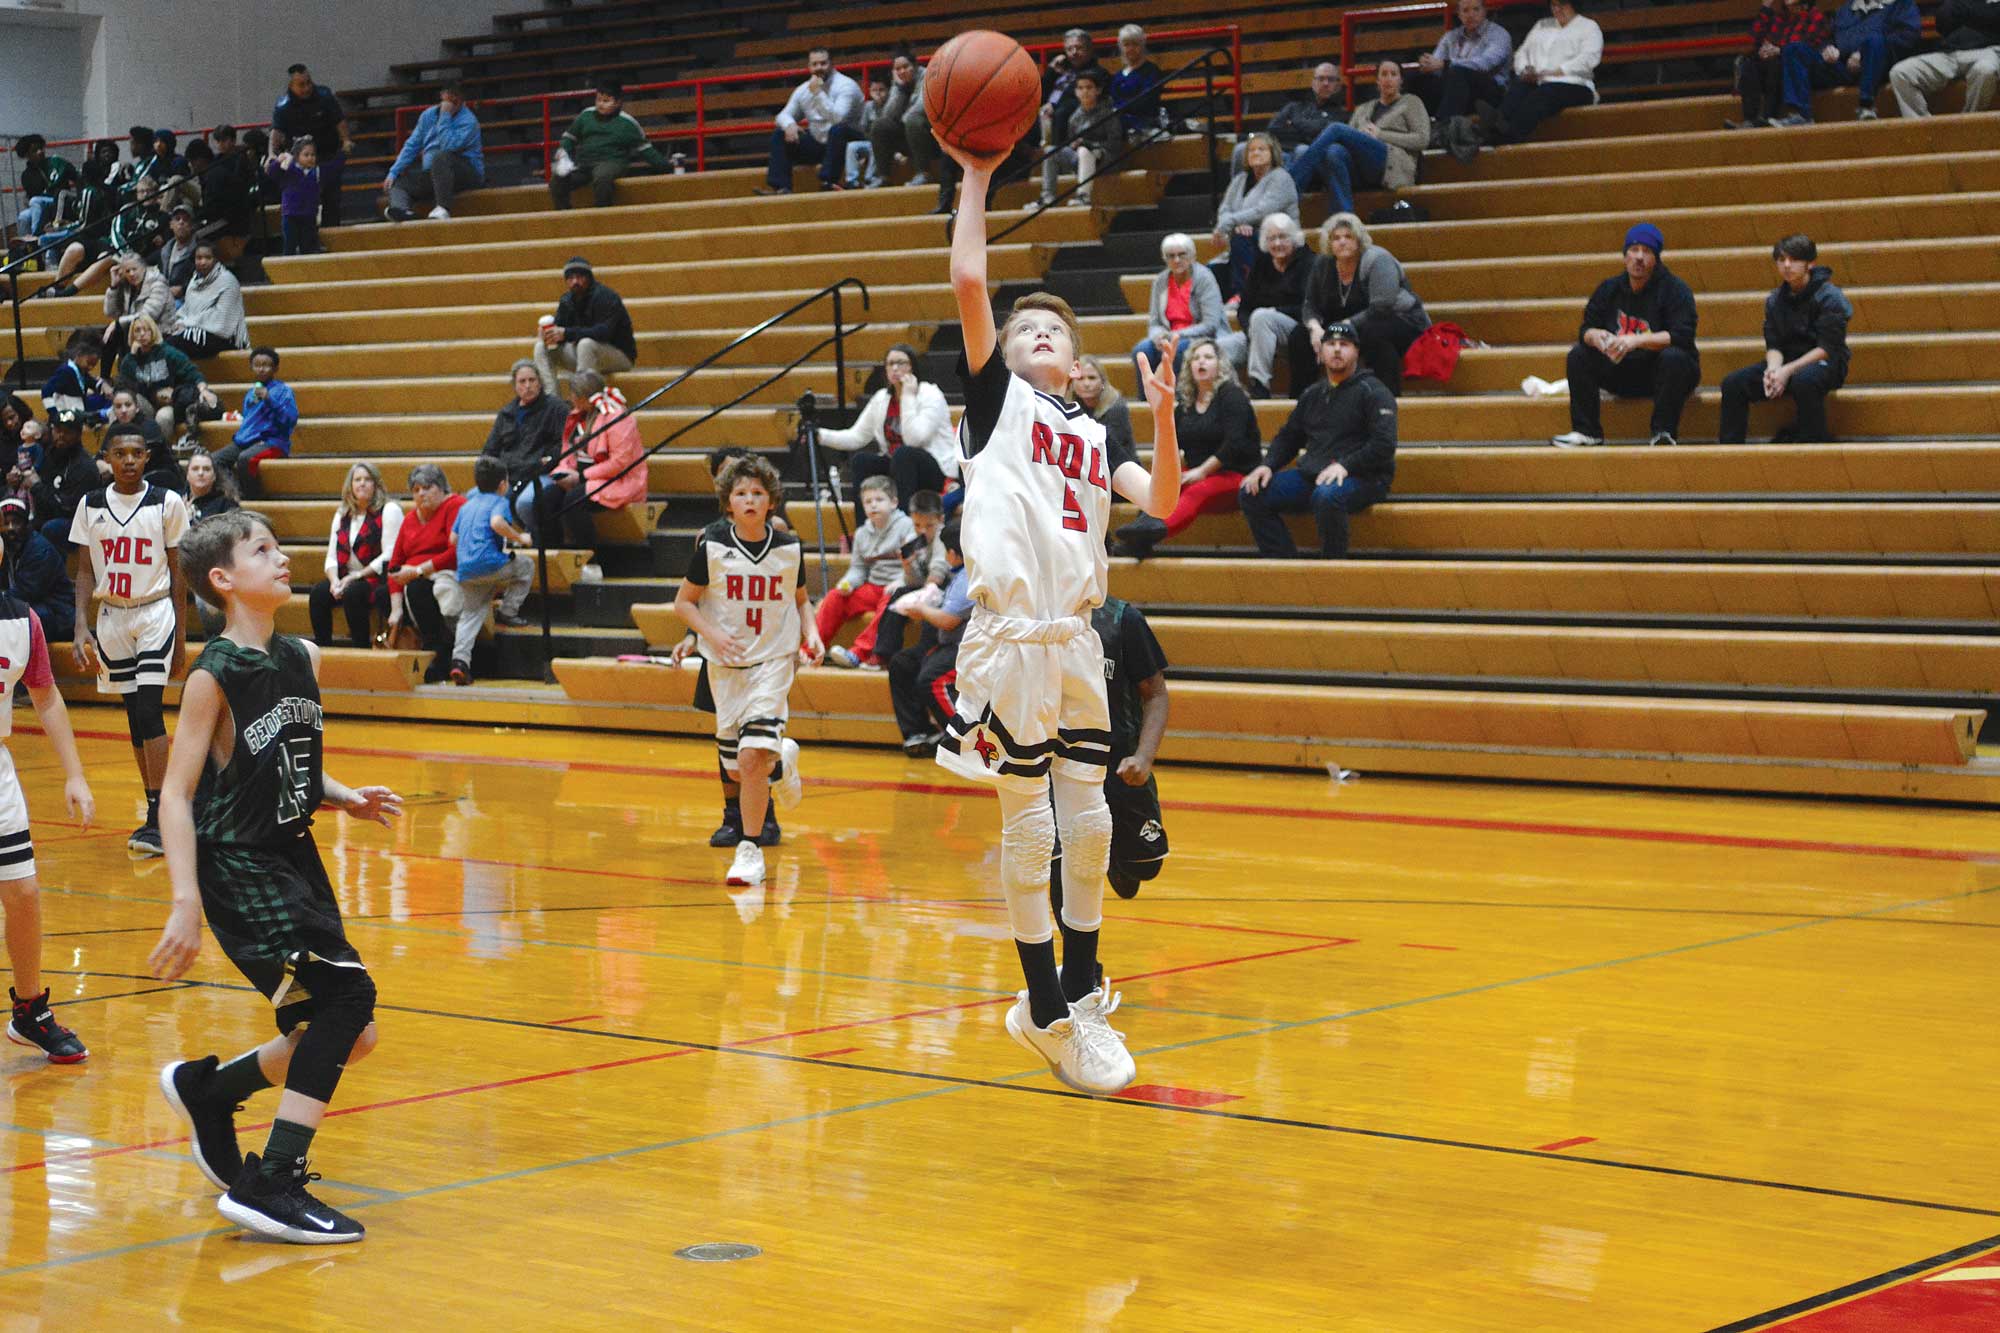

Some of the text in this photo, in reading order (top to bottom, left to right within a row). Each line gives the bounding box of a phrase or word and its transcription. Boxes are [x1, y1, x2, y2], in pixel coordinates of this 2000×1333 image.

[1062, 480, 1088, 533] 5
[108, 572, 132, 599] 10
[726, 574, 783, 601] RDC
[746, 607, 762, 636] 4
[412, 656, 420, 673] A
[1966, 716, 1974, 737] A
[277, 737, 312, 824] 15
